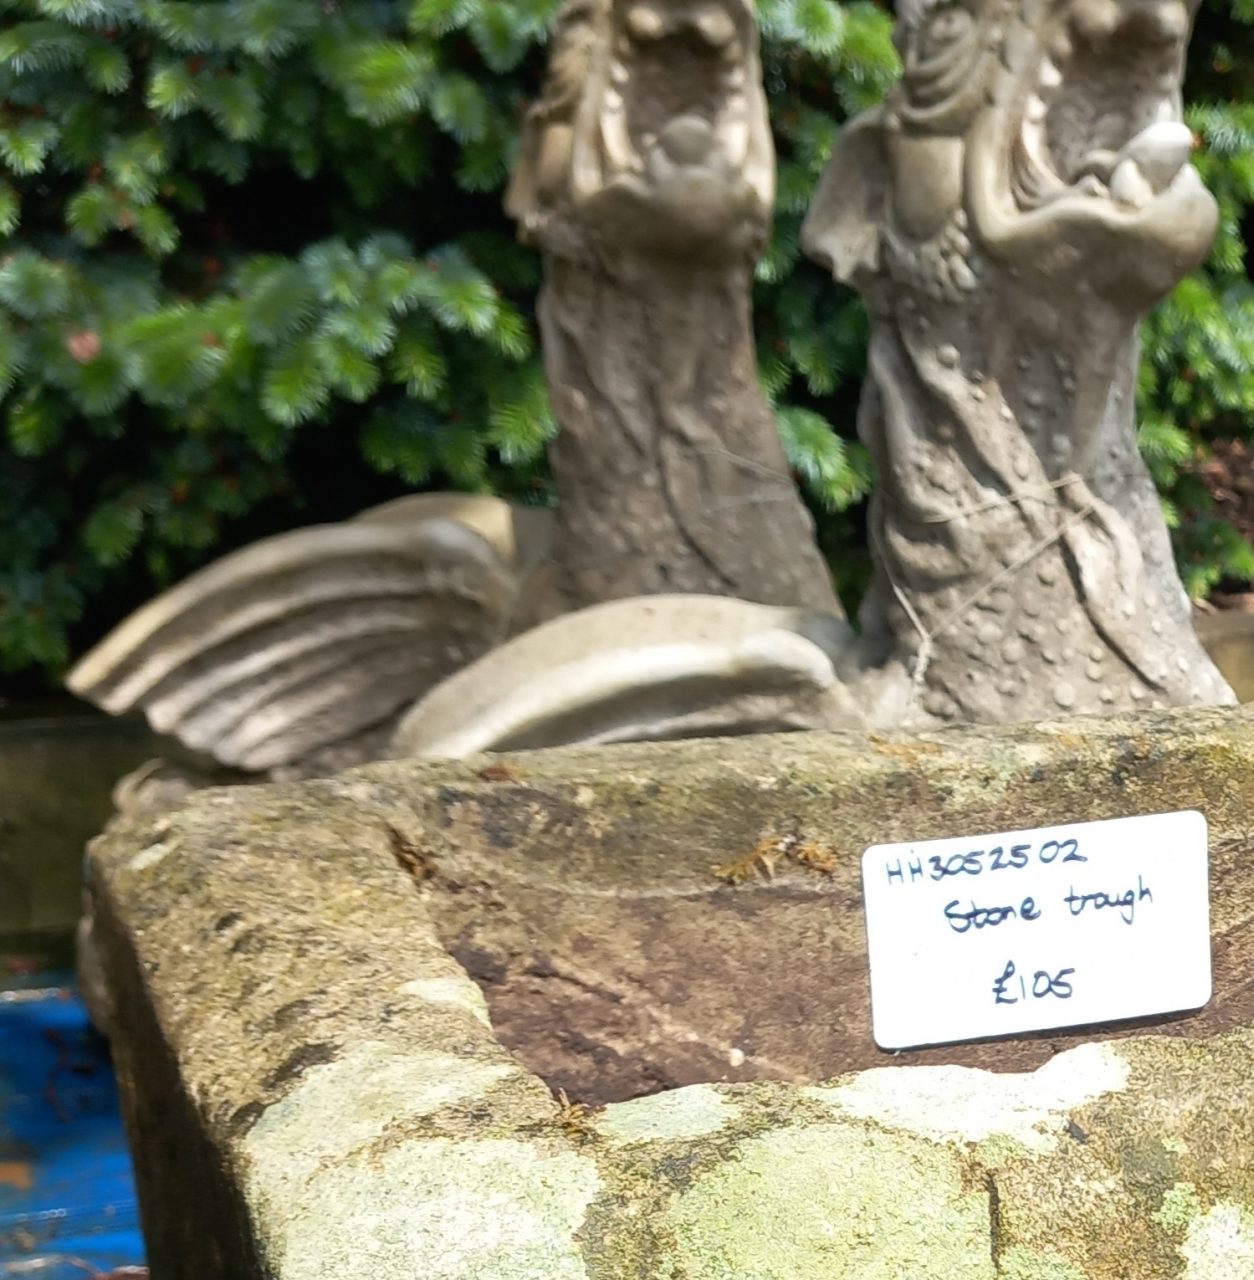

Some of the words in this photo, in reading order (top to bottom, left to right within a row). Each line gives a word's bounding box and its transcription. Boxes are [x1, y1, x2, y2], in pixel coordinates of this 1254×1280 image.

[943, 896, 1041, 933] Stone
[1064, 874, 1153, 925] trough
[992, 959, 1076, 1004] £105
